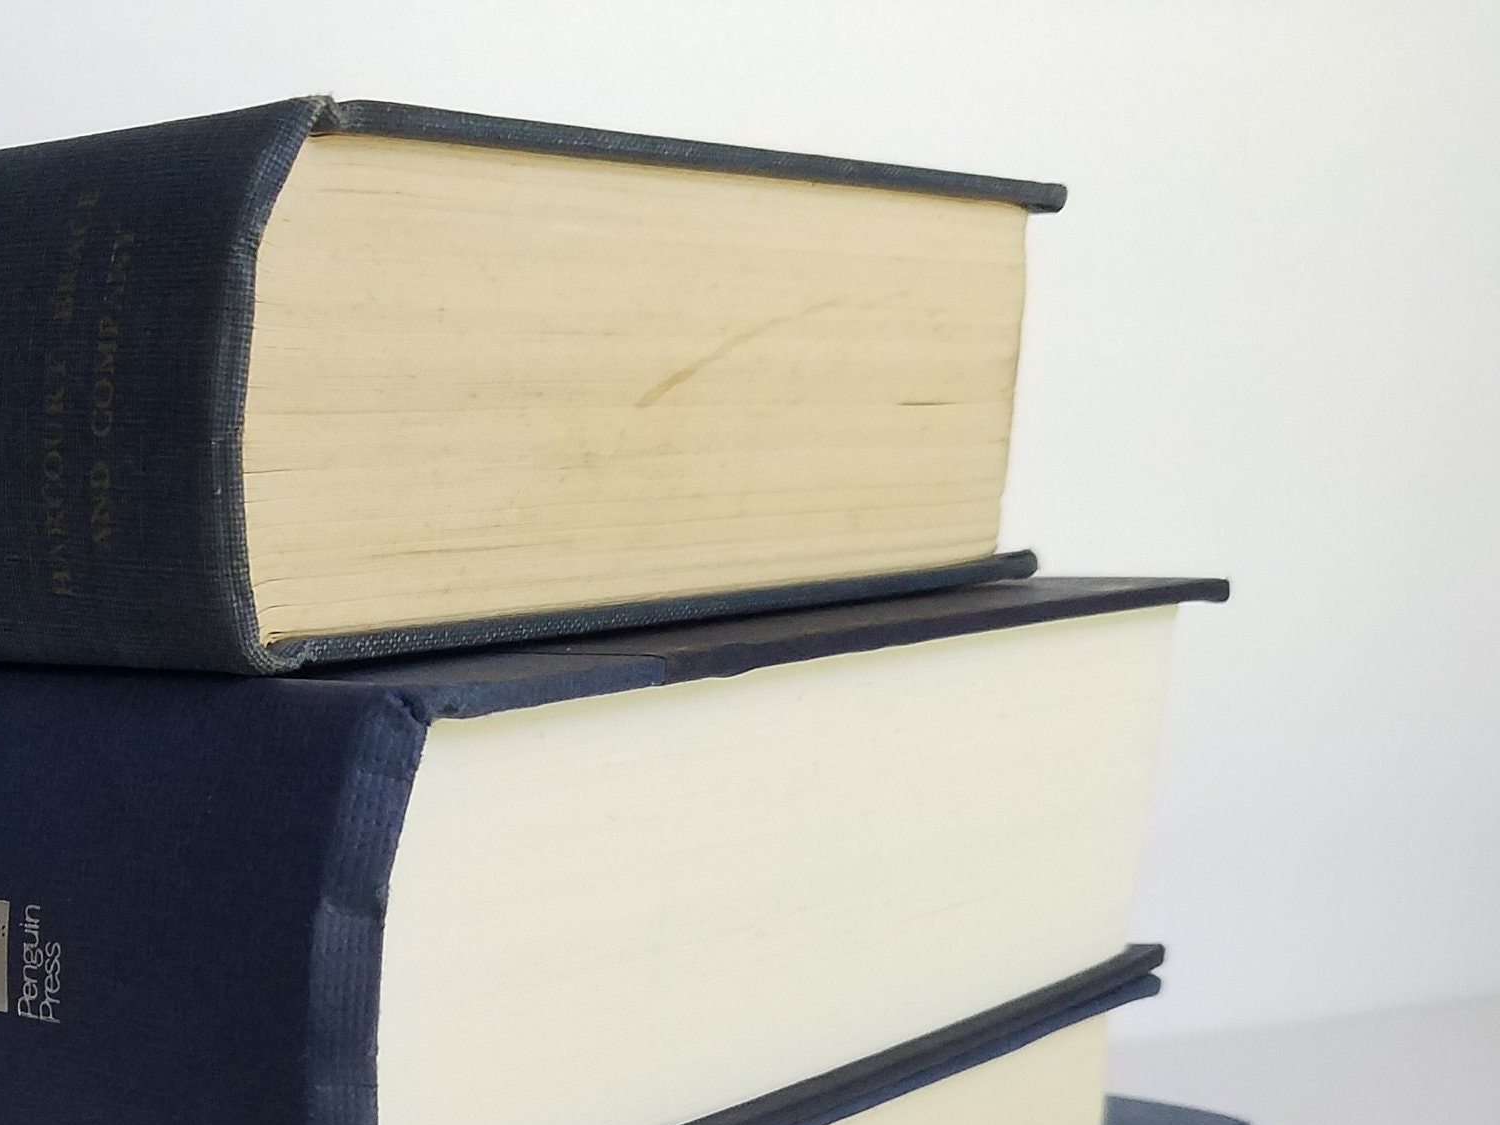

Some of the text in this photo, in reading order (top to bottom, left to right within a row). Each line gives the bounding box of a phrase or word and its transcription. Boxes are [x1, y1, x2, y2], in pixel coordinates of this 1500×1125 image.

[42, 350, 76, 597] HARCOURT
[89, 226, 137, 550] AND COMPANY
[18, 904, 44, 1019] Penguin
[39, 941, 61, 1024] Press
